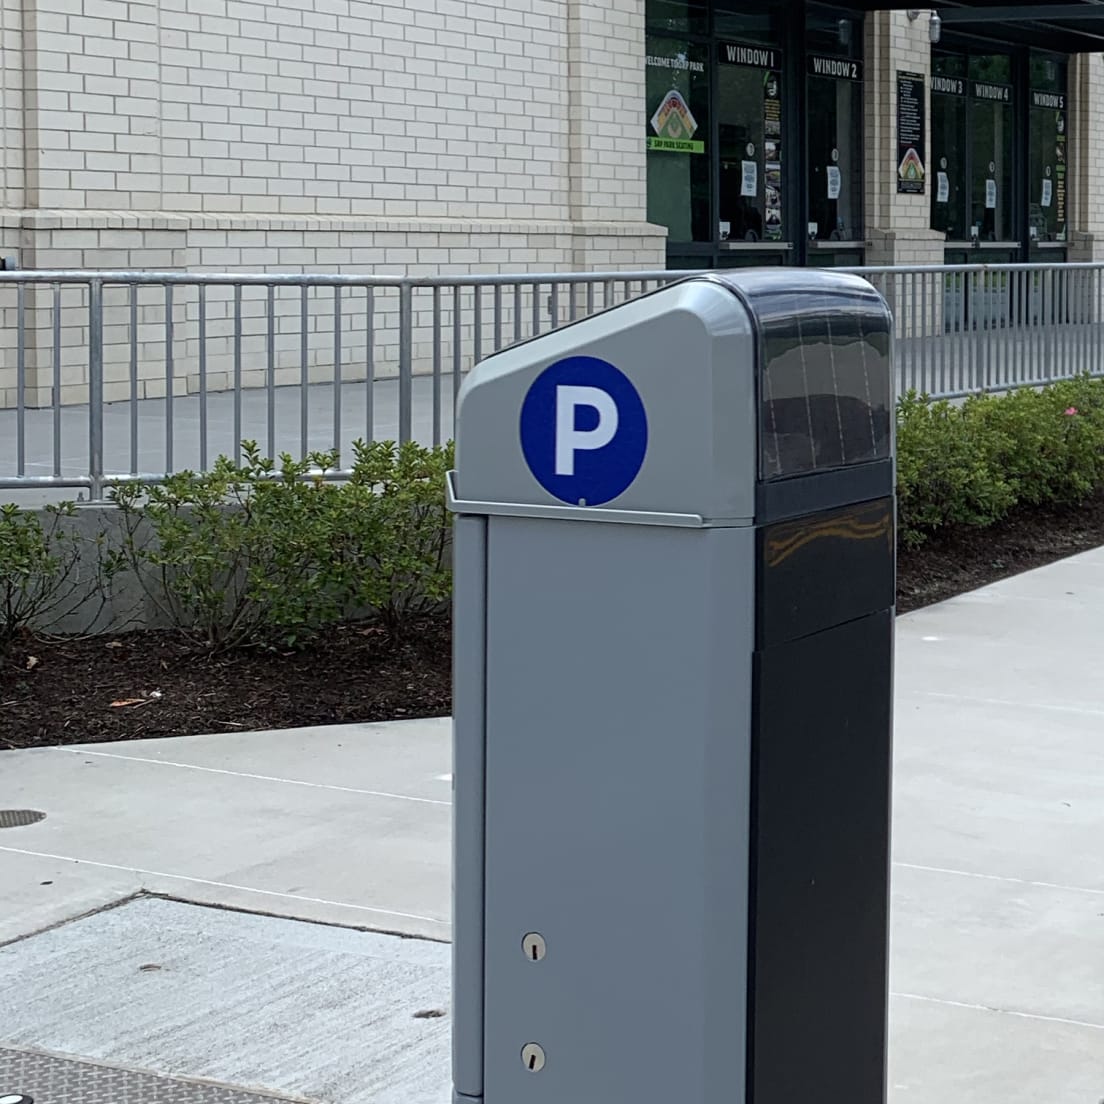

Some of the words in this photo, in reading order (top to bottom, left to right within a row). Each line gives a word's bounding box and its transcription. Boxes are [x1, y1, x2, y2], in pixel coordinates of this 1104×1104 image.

[727, 45, 767, 67] WINDOW
[770, 51, 774, 68] 1
[814, 58, 849, 76] WINDOW
[851, 64, 857, 78] 2
[958, 80, 963, 94] 3
[976, 84, 1002, 99] WINDOW
[1004, 88, 1008, 101] 4
[1034, 93, 1058, 107] WINDOW
[1060, 97, 1063, 108] 5
[556, 385, 618, 475] P
